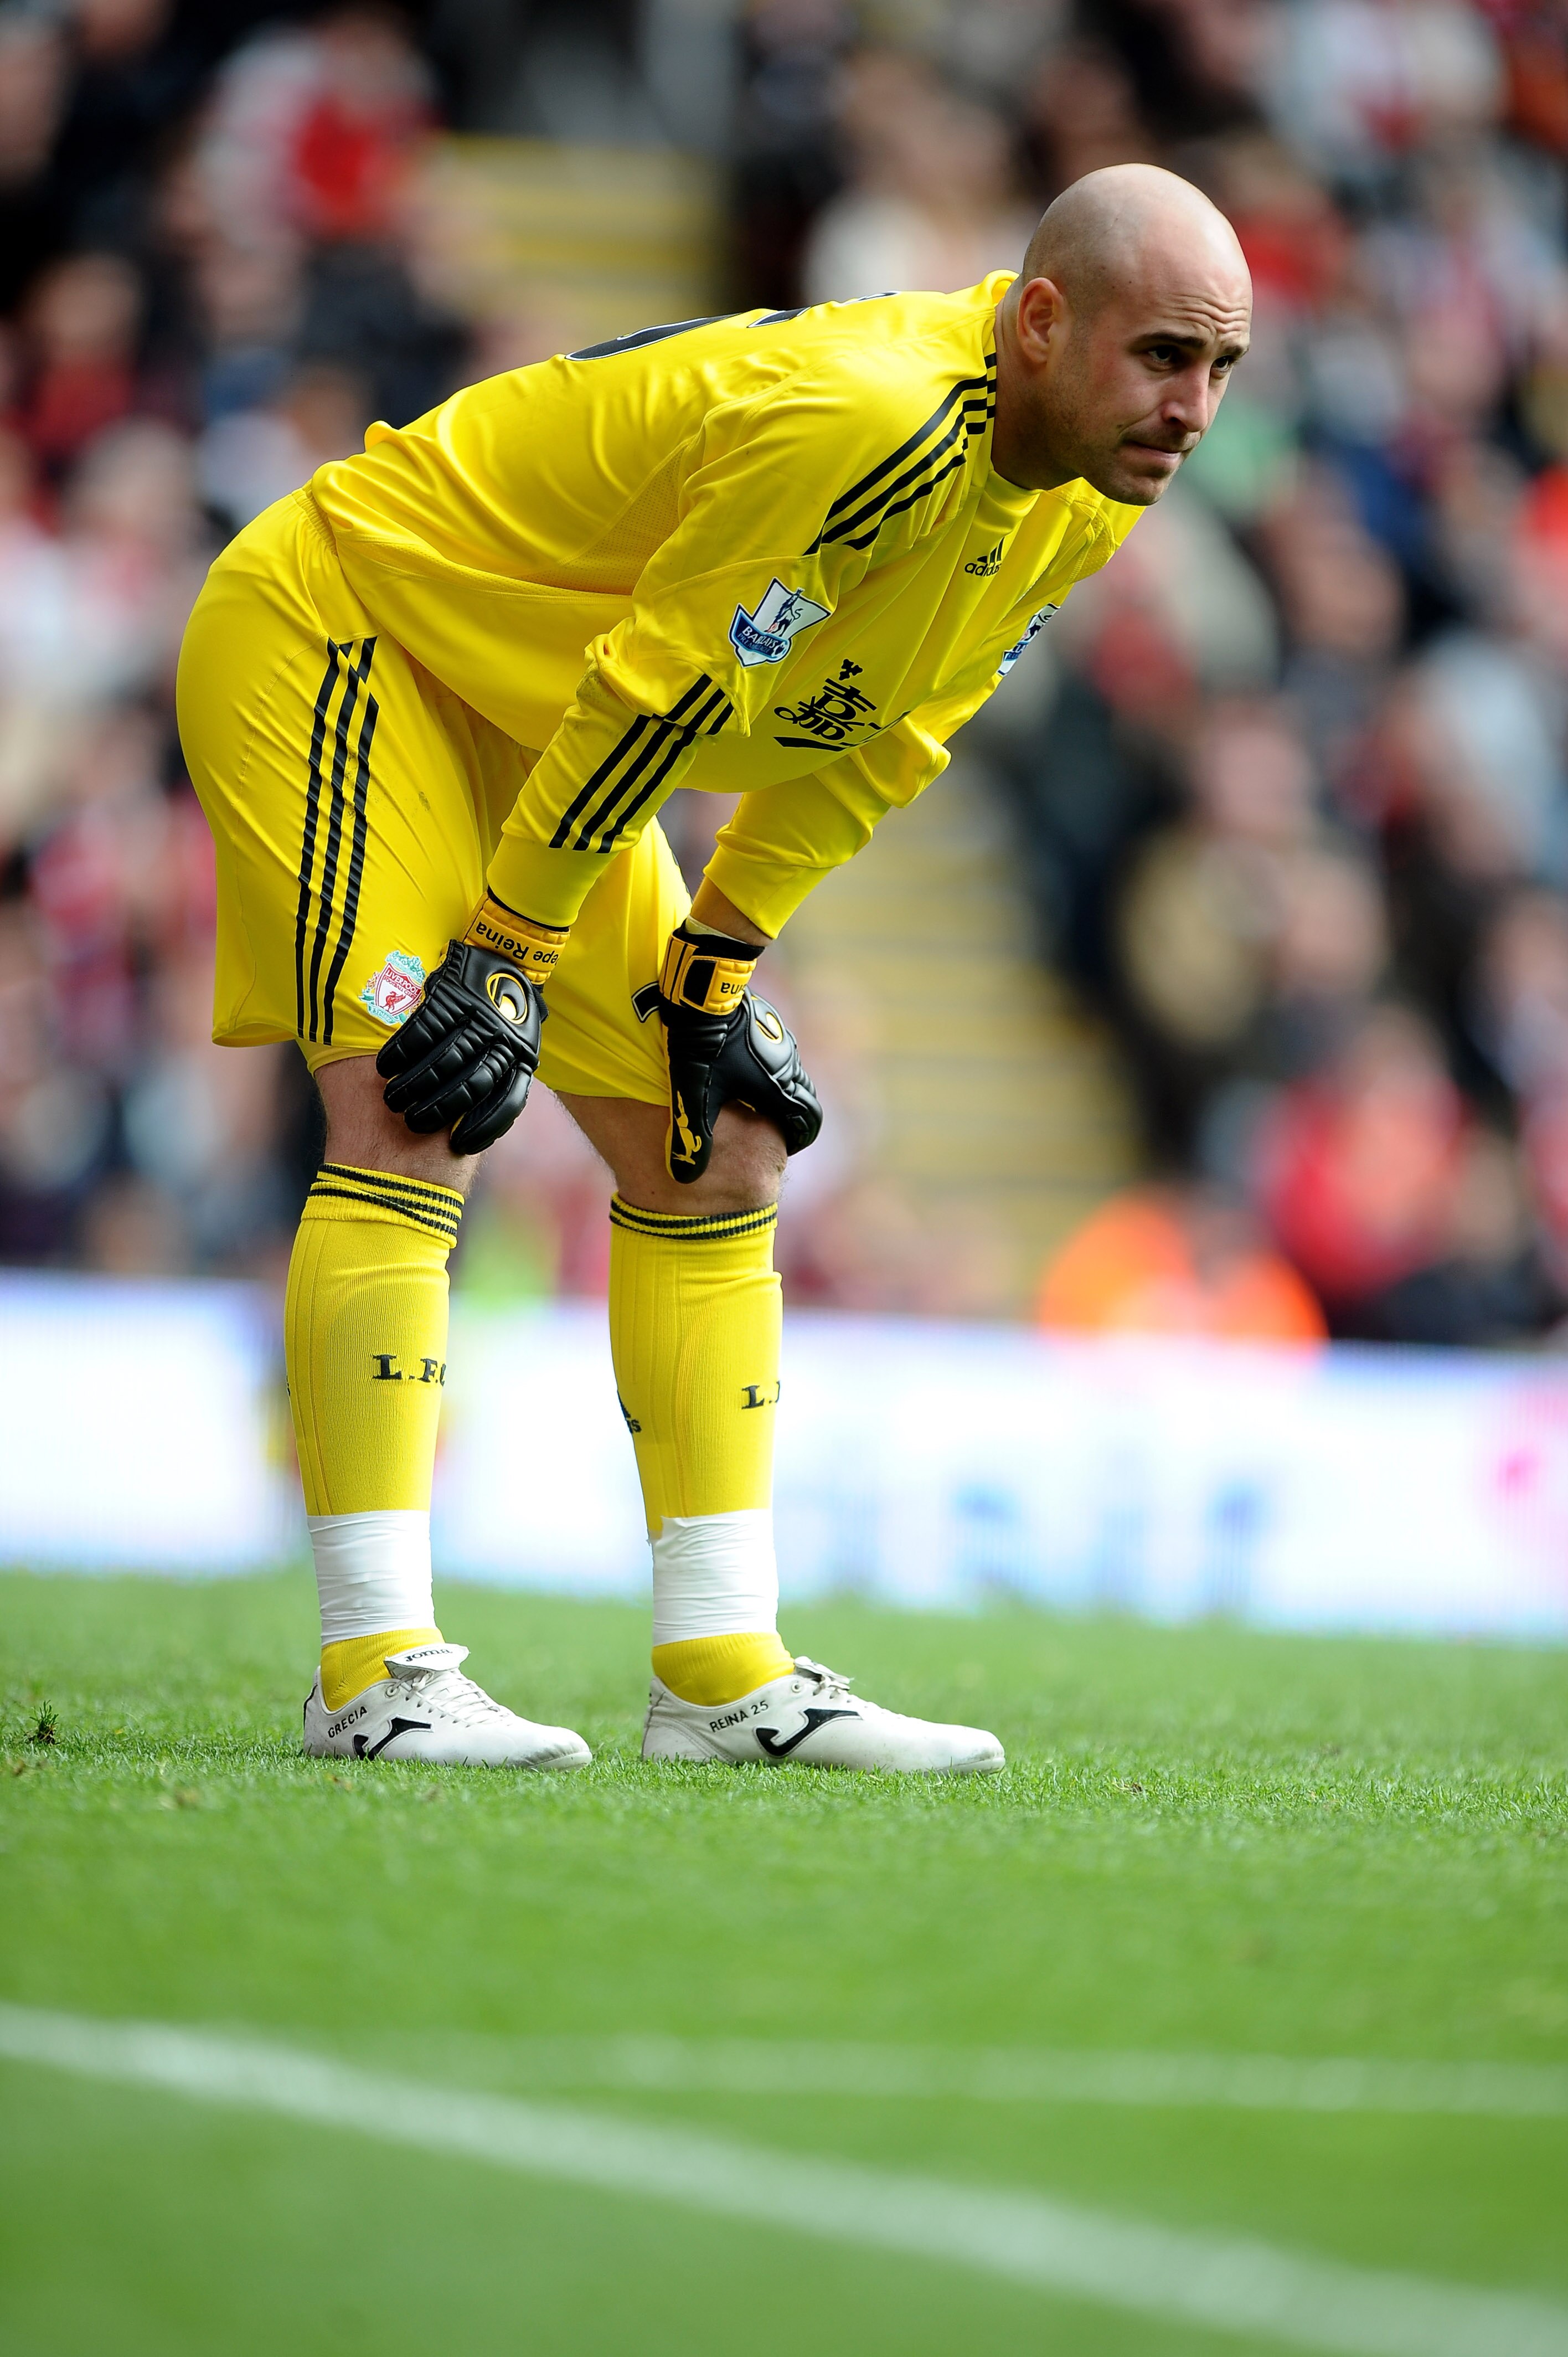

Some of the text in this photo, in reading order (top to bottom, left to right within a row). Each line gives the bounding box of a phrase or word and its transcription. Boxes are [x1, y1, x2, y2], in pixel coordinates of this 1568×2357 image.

[742, 626, 778, 649] BARLAYS
[476, 922, 559, 966] epe Reina
[385, 969, 419, 995] LIVERPOOL
[327, 1706, 368, 1738] GRECIA
[709, 1700, 768, 1733] REINA 25
